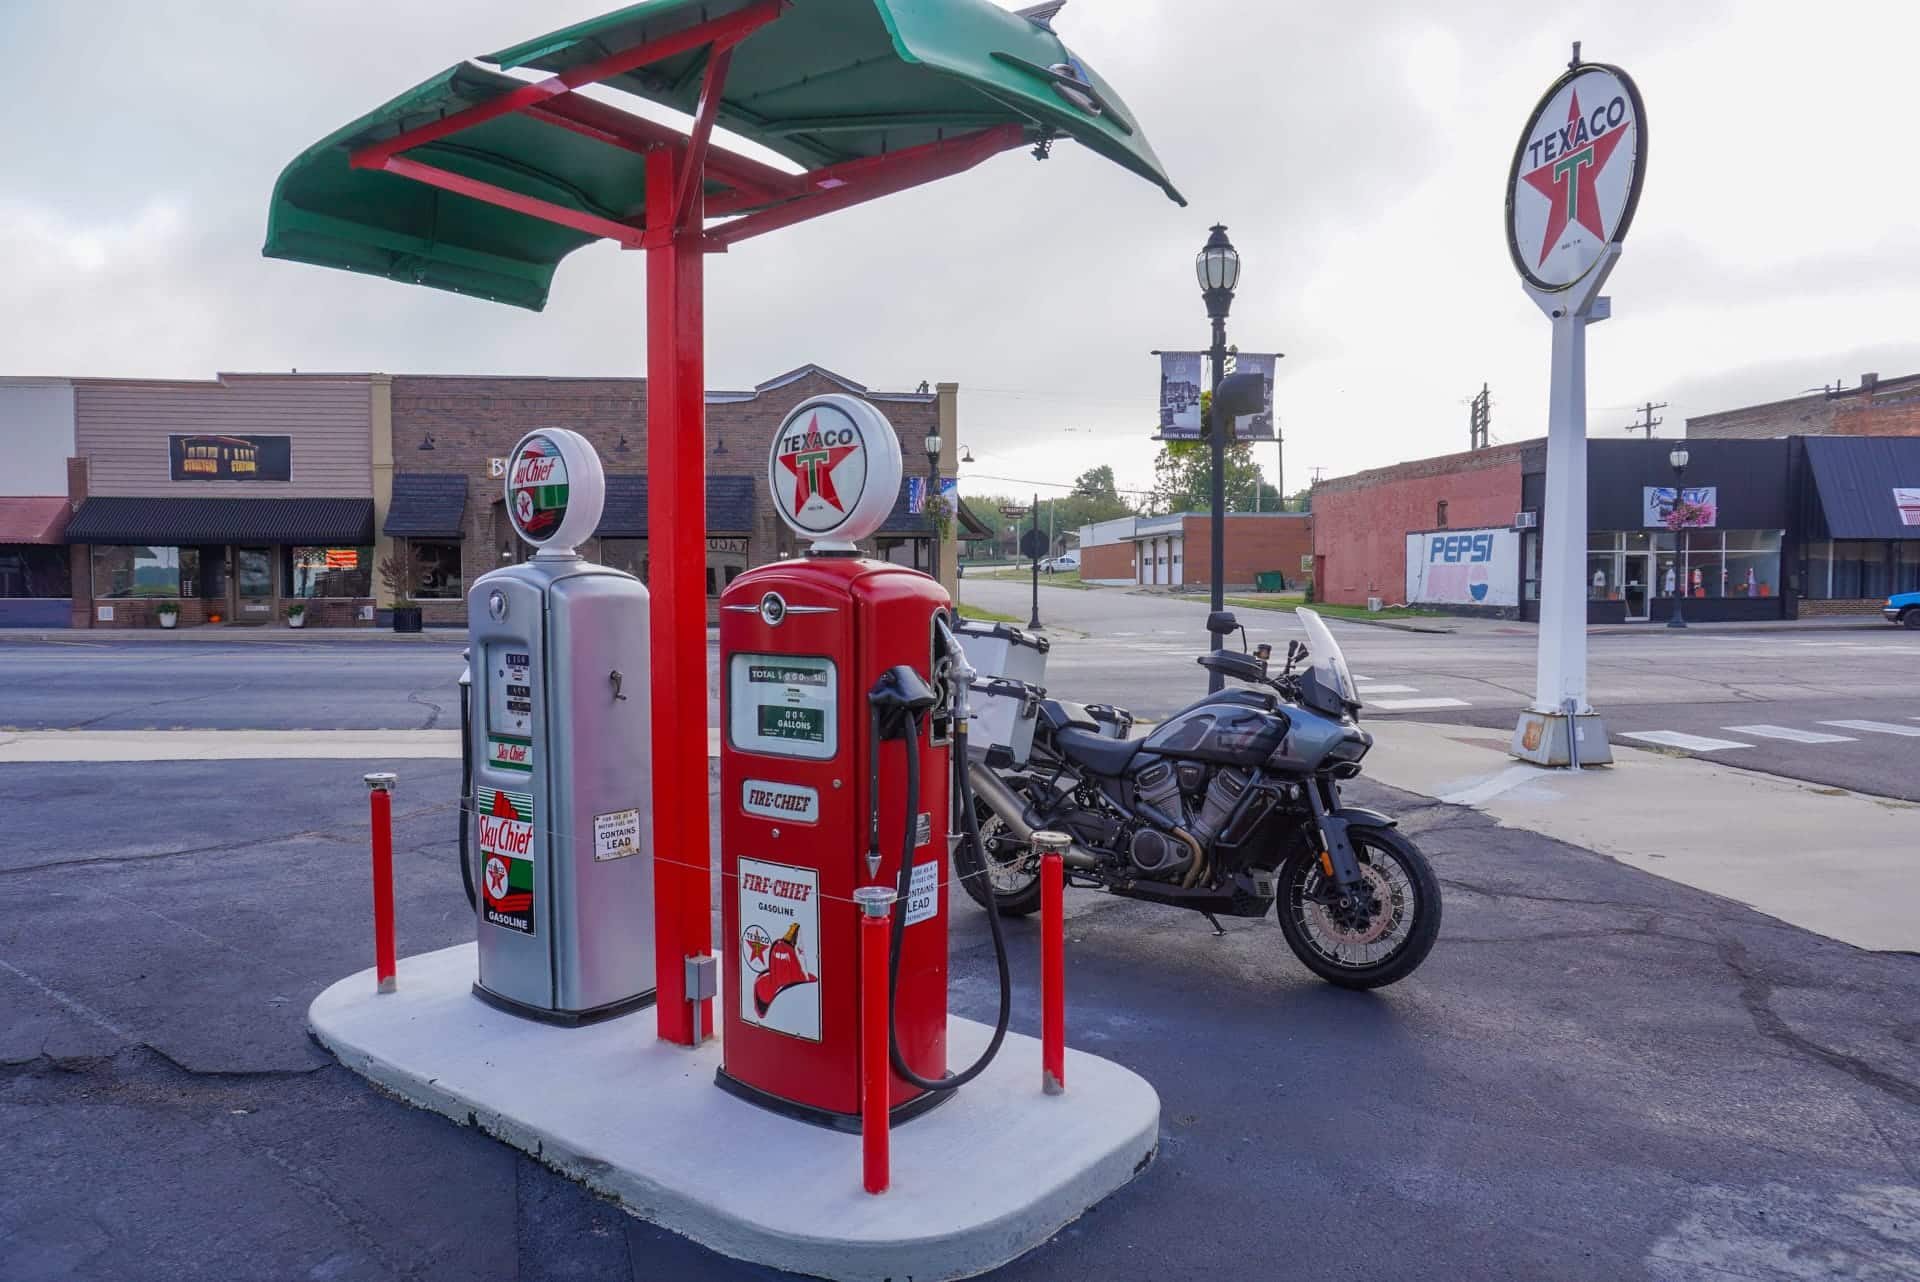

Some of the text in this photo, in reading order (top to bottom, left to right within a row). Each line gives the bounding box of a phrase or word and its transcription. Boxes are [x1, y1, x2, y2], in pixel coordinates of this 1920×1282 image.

[1529, 96, 1625, 168] TEXACO
[783, 428, 854, 453] TEXACO
[526, 457, 556, 482] Chief
[1429, 534, 1494, 563] PEPSI
[751, 670, 776, 679] TOTAL
[777, 719, 811, 730] GALLONS
[496, 743, 527, 762] Sky Chief
[480, 815, 533, 855] Sky Chief
[600, 826, 636, 840] CONTAINS
[606, 837, 631, 850] LEAD
[758, 902, 795, 917] GASOLINE
[907, 896, 930, 913] LEAD
[488, 911, 528, 930] GASOLINE
